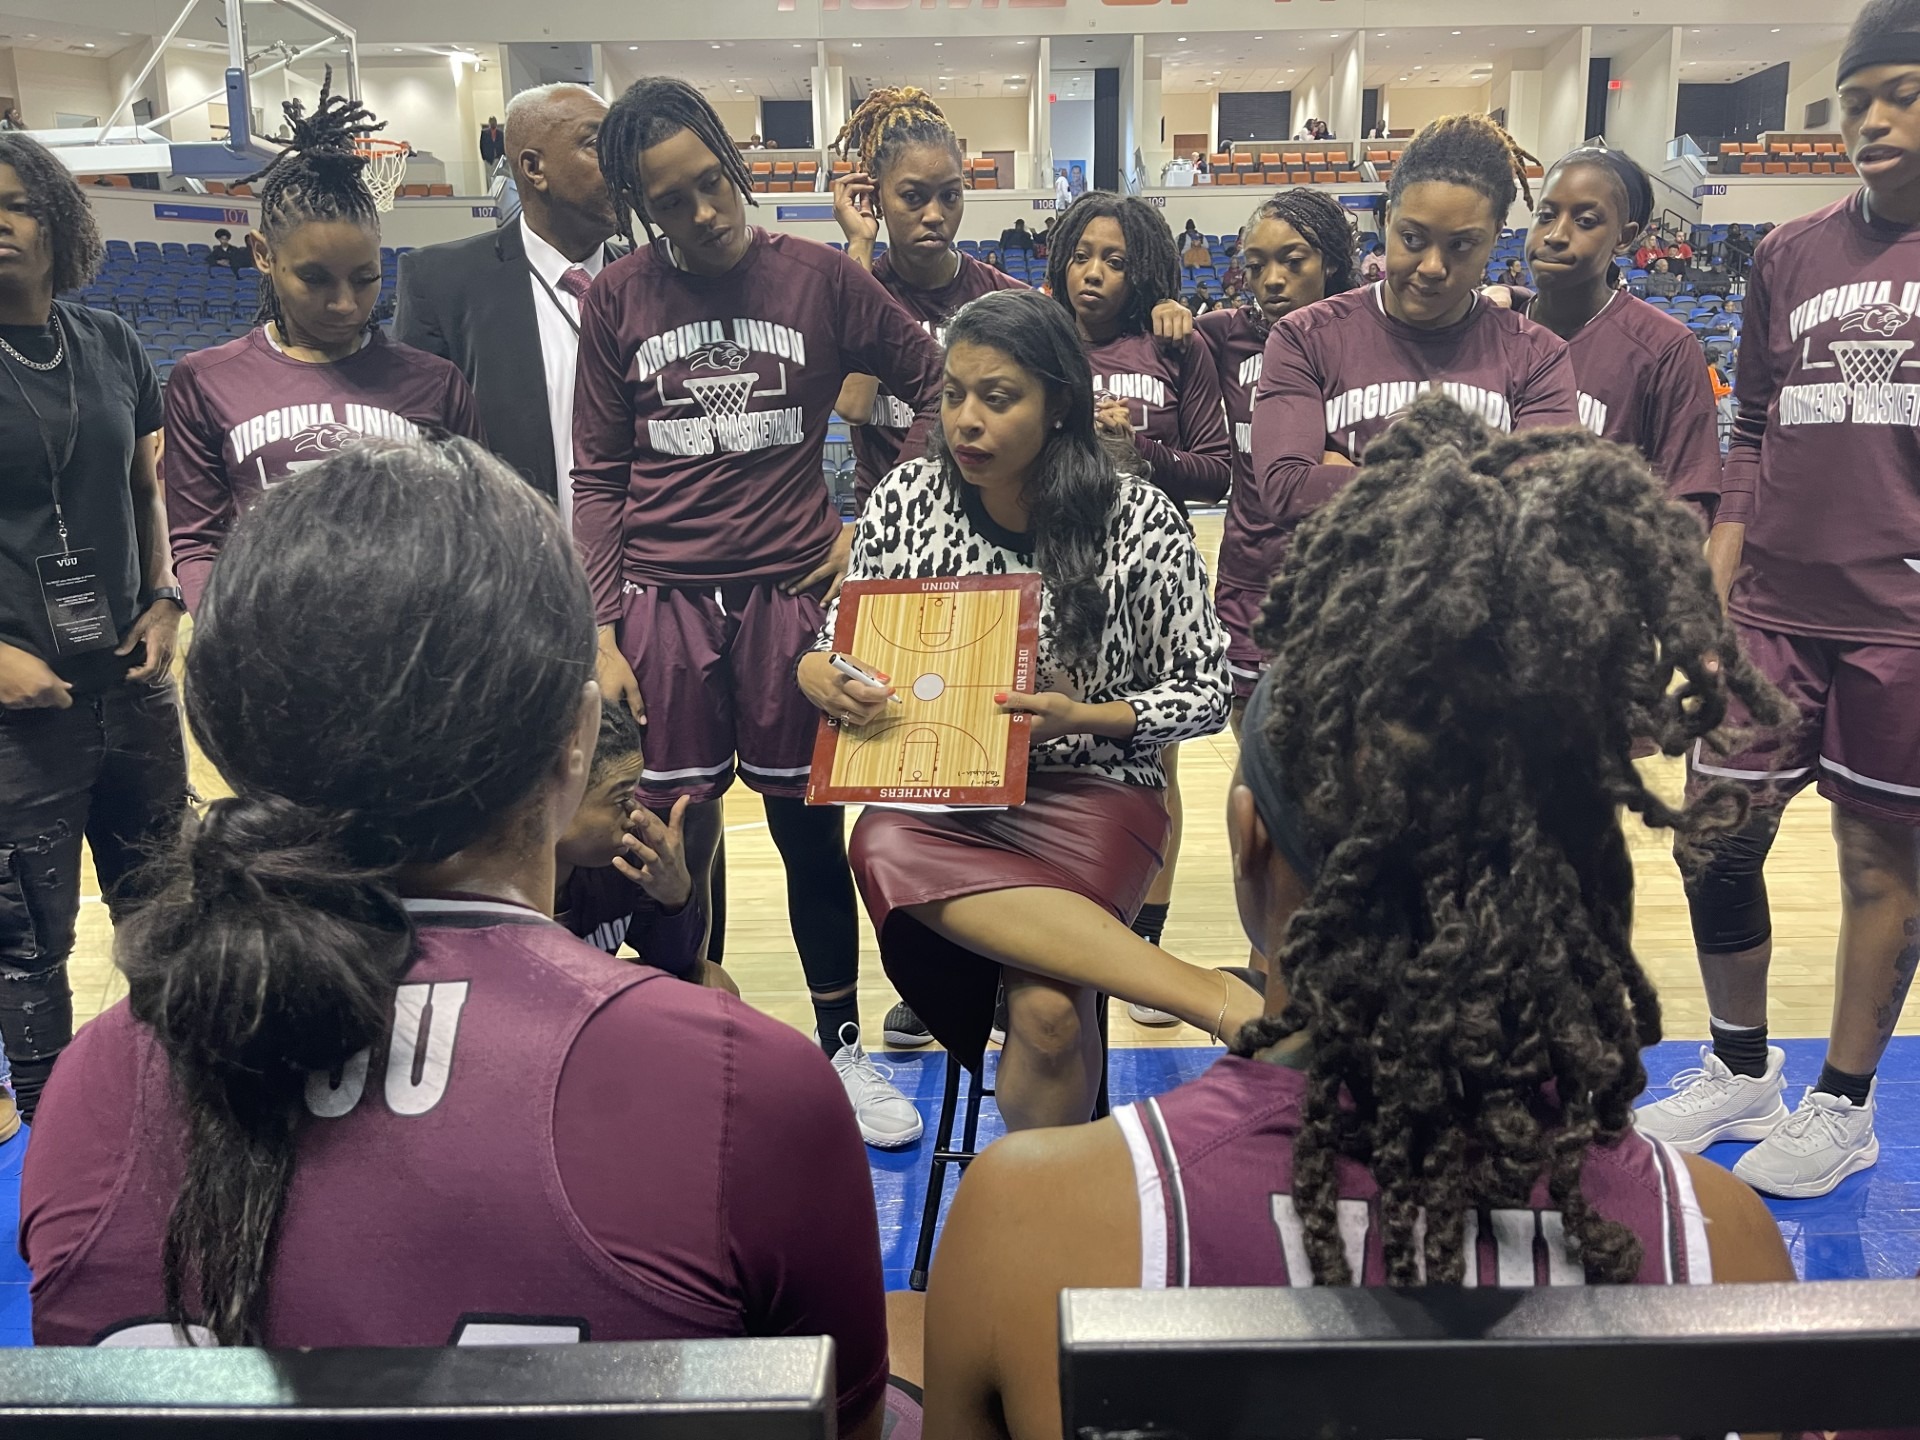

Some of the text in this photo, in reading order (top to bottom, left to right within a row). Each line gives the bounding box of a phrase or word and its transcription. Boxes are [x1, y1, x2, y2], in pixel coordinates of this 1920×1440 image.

[1711, 185, 1726, 195] 110
[478, 207, 493, 217] 107
[1038, 199, 1055, 209] 108
[222, 208, 246, 224] 107
[1789, 280, 1892, 343] VIRGINIA
[635, 318, 806, 382] VIRGINIA UNION
[1108, 373, 1164, 408] UNION
[1852, 383, 1920, 426] BASKET
[229, 403, 419, 464] VIRGINIA UNION
[715, 406, 804, 452] BASKETBALL
[56, 557, 78, 568] VUU
[921, 581, 960, 591] UNION
[879, 788, 951, 798] PANTHERS
